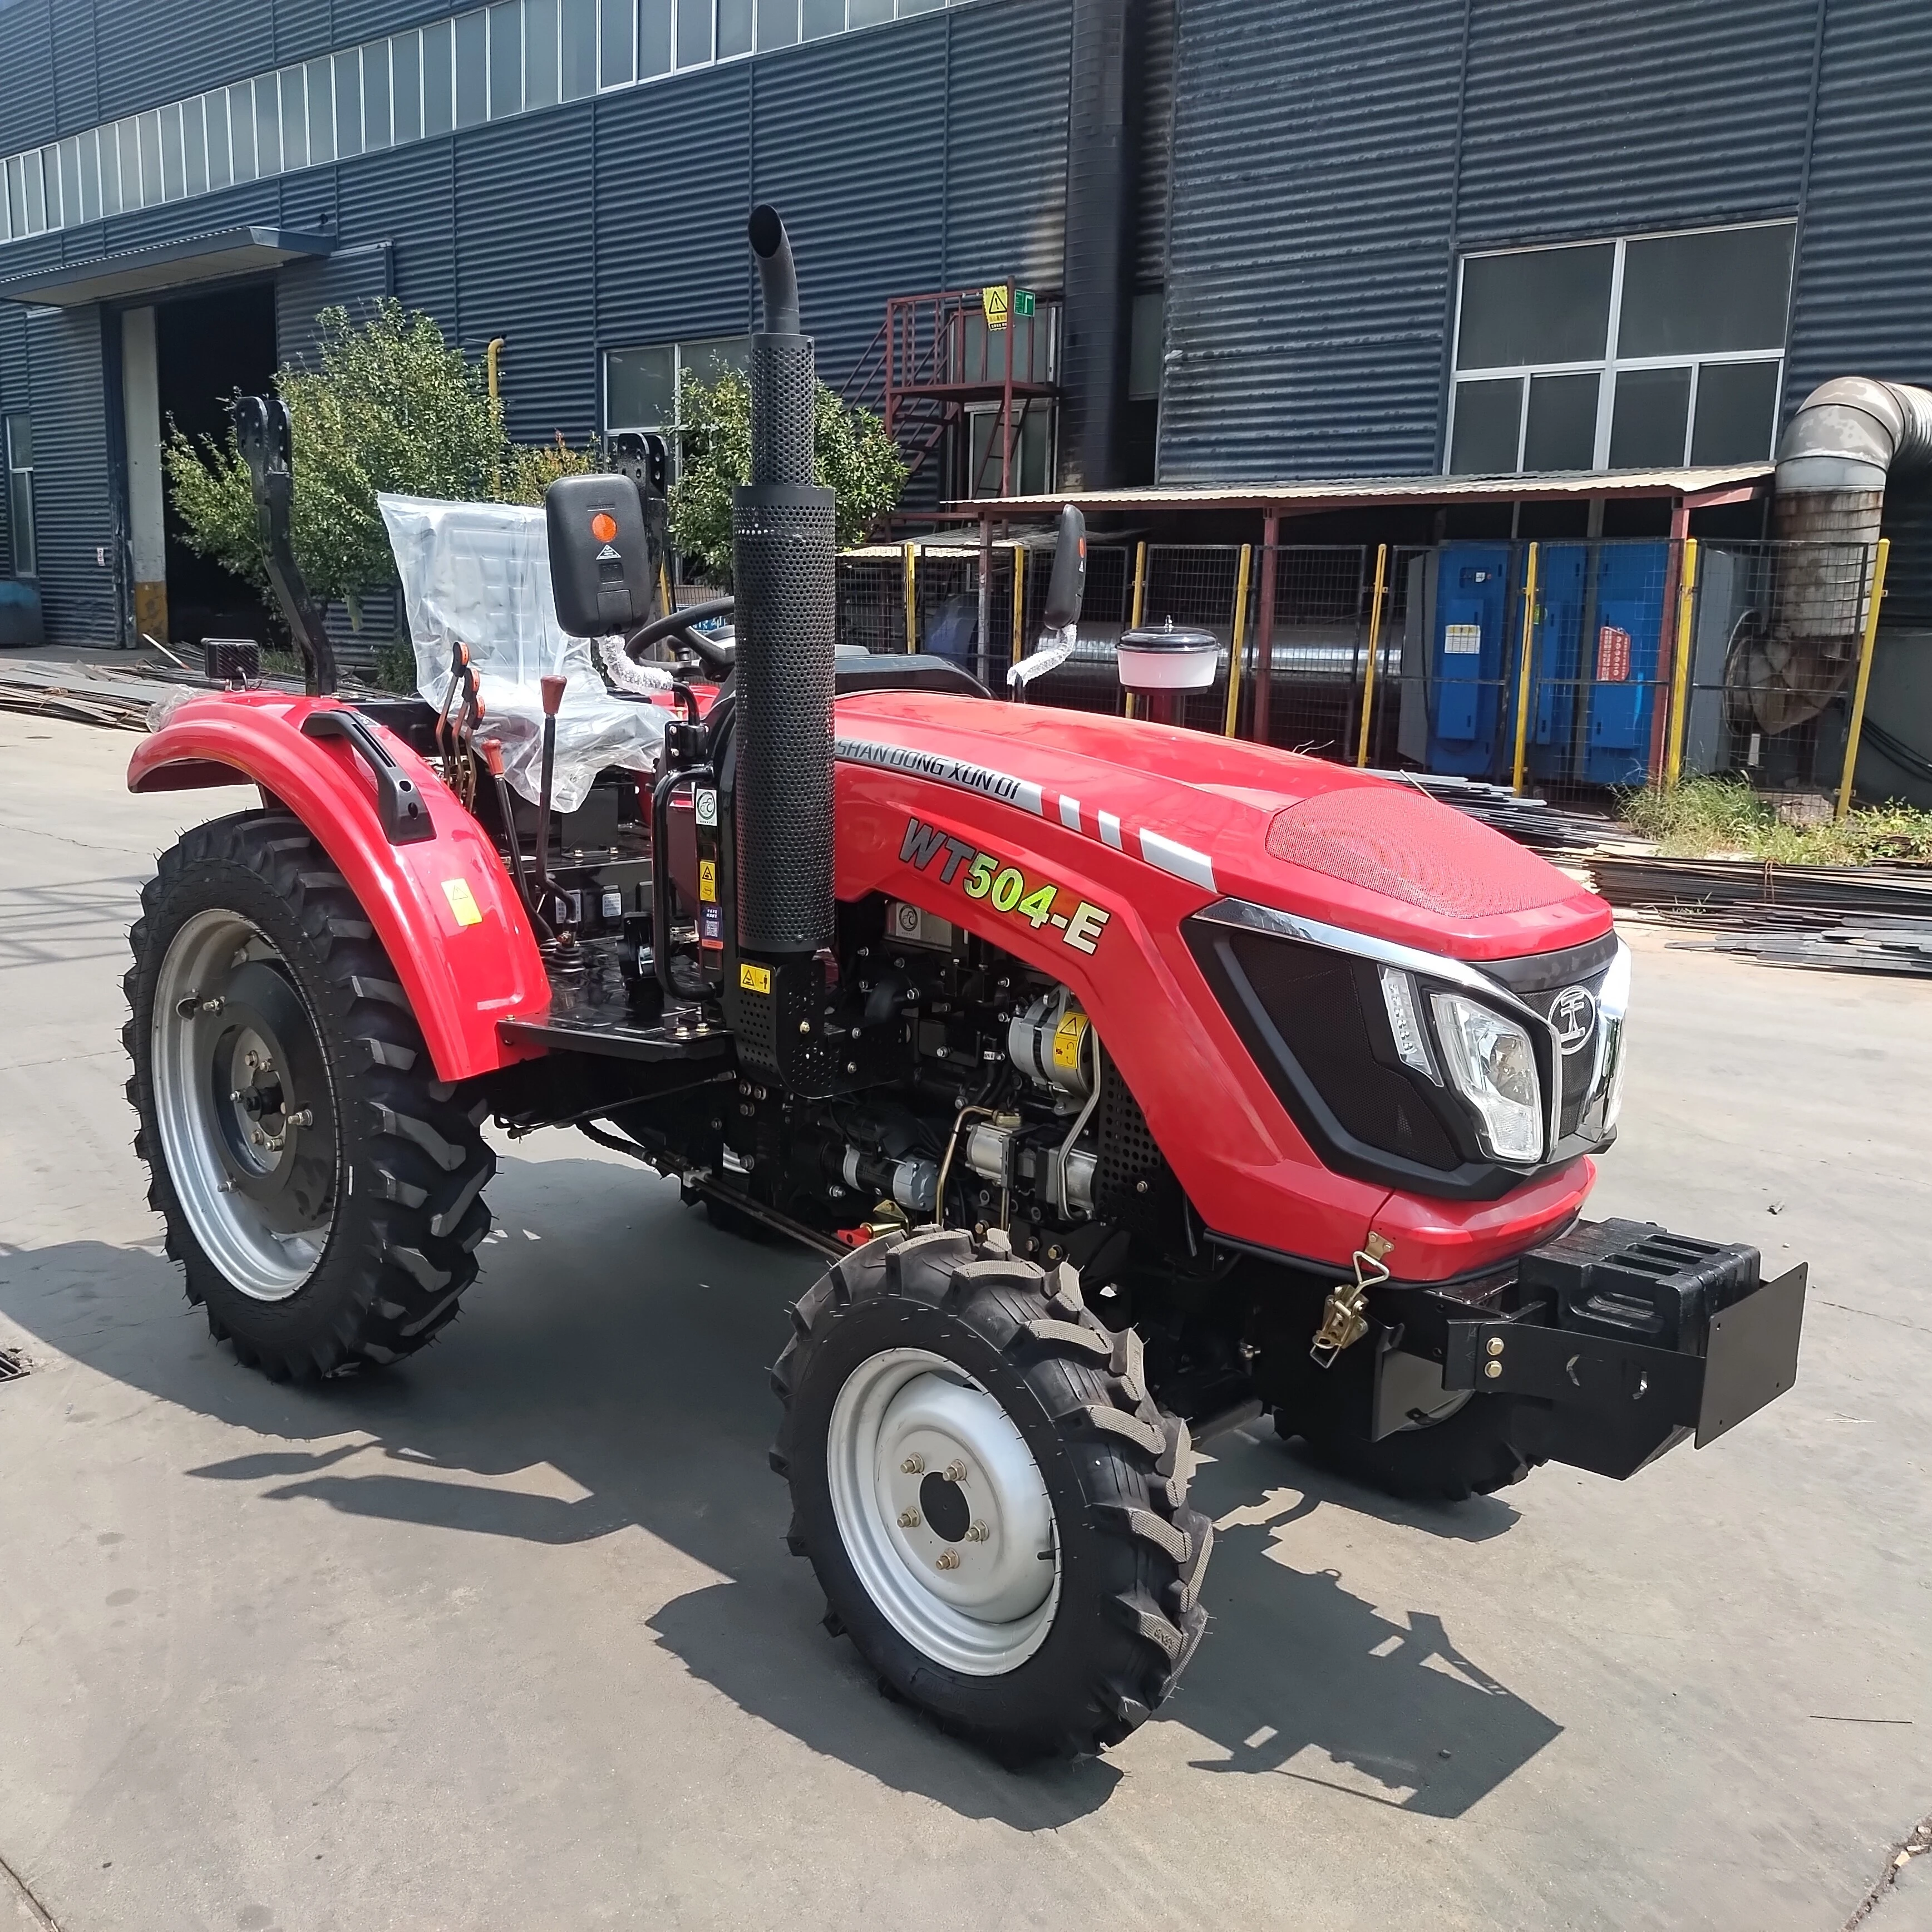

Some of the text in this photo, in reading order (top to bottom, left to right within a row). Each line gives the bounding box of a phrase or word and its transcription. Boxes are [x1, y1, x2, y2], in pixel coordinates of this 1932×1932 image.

[836, 739, 890, 762] SHAN
[890, 748, 949, 776] DONG
[948, 762, 995, 790] XUN
[899, 818, 1110, 954] WT504-E
